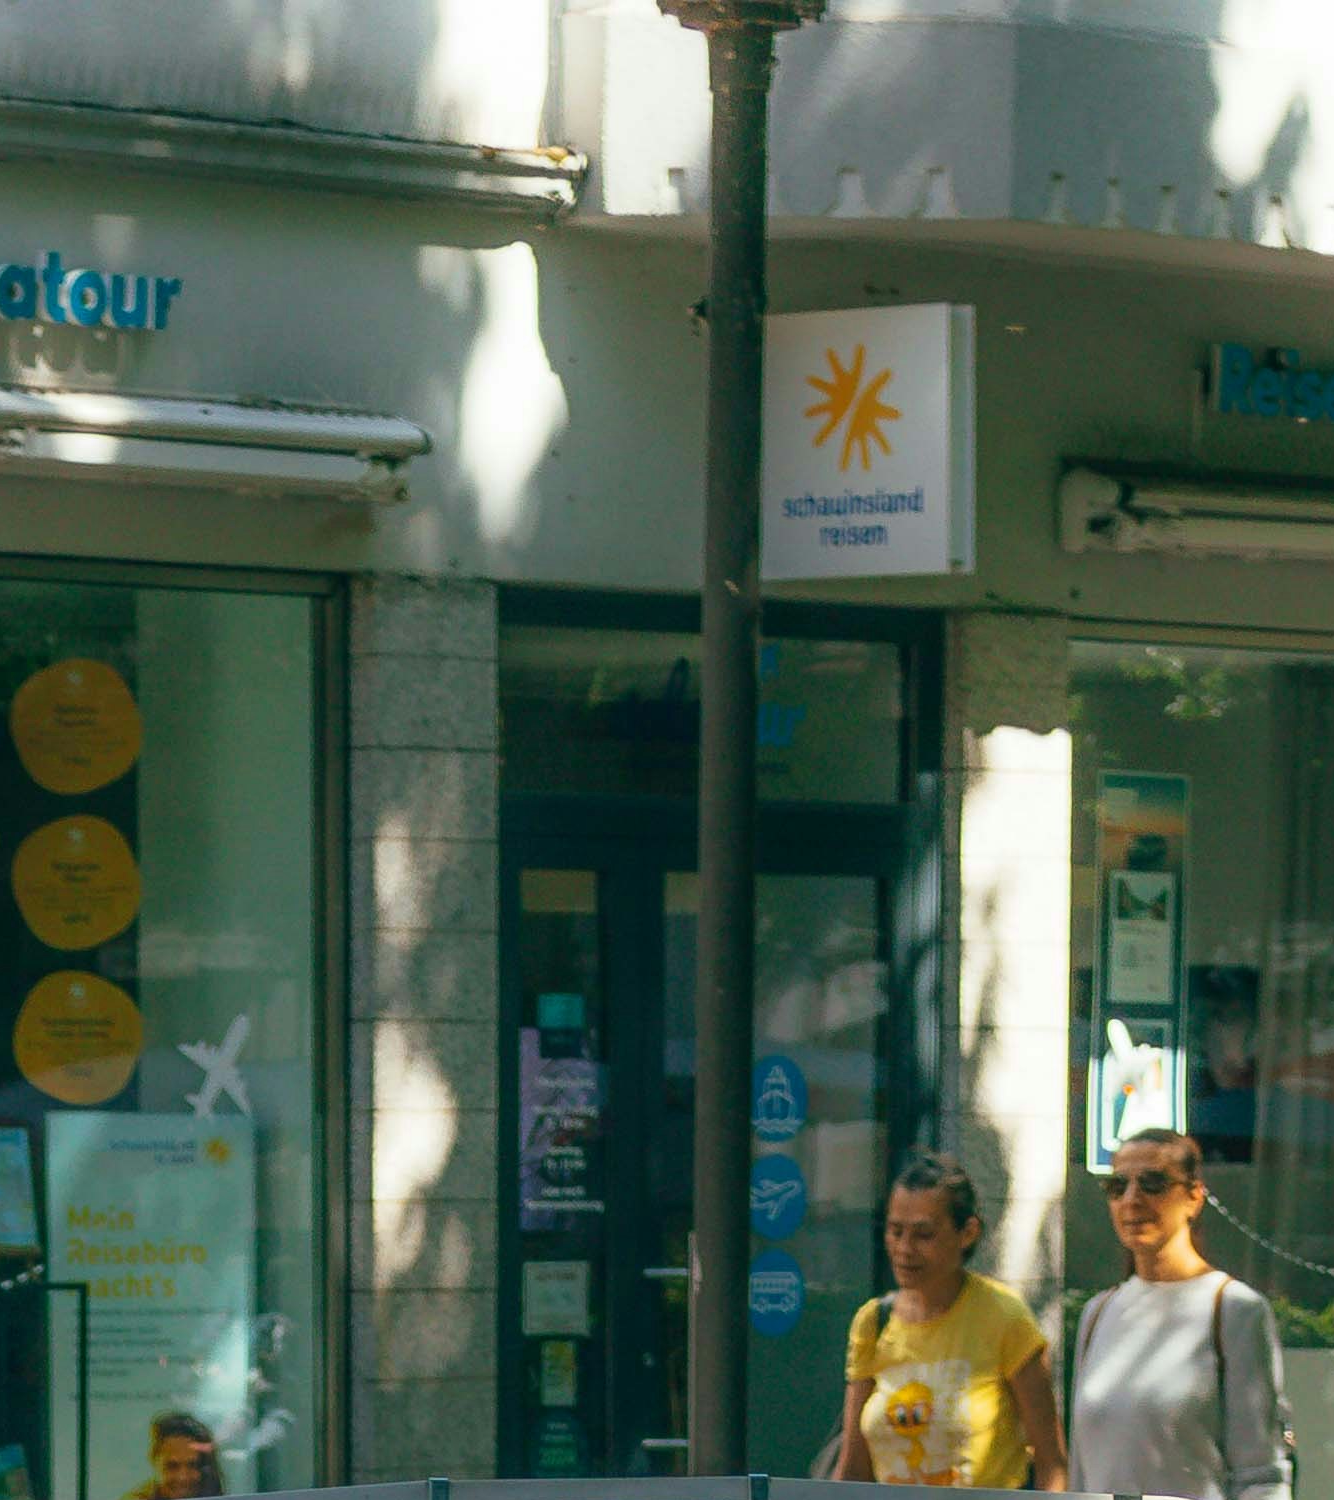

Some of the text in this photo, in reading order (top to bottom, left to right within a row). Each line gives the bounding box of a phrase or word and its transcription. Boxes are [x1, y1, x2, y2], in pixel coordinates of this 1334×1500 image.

[781, 485, 924, 519] schauinsland
[818, 521, 890, 547] reisen
[66, 1205, 135, 1231] Mein
[67, 1236, 208, 1265] Reisebüro
